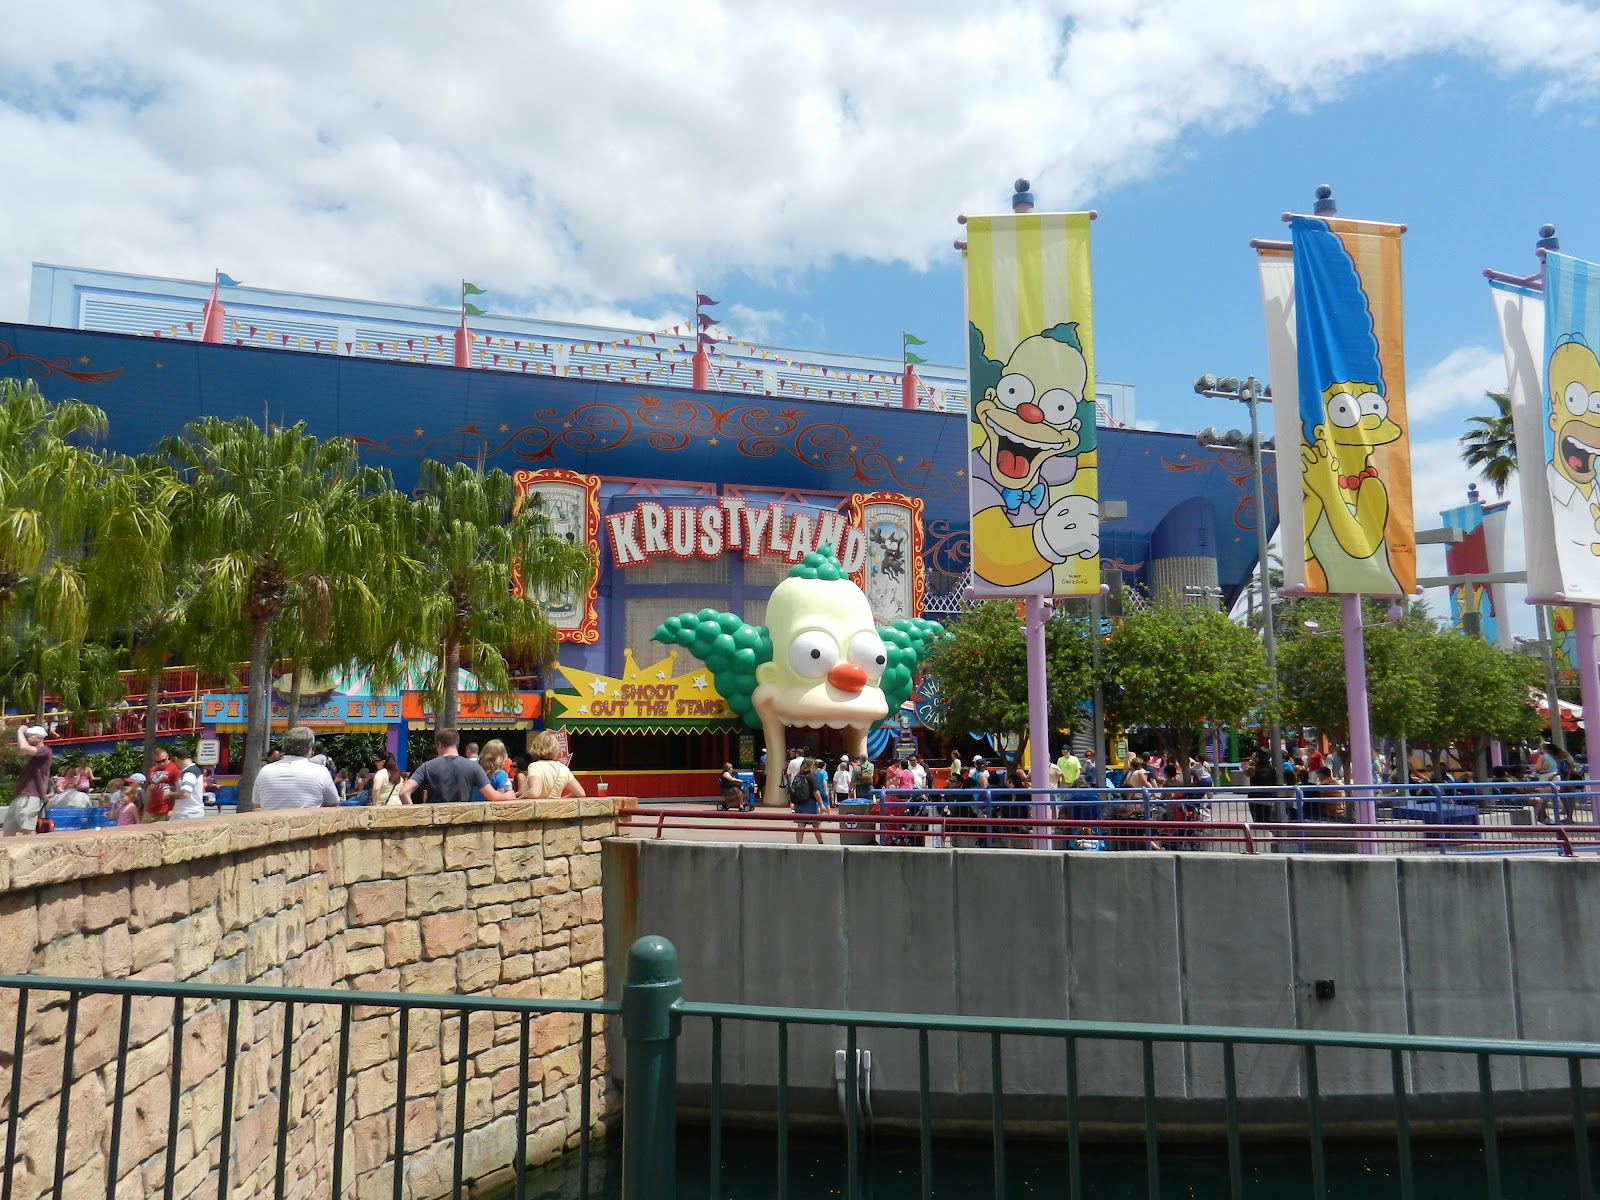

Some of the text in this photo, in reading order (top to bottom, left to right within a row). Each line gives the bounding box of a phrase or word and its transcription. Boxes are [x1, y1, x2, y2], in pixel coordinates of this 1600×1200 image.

[608, 497, 867, 575] KRUSTYLAND
[620, 684, 679, 700] SHOOT
[204, 700, 249, 717] PI
[298, 705, 340, 718] YOUR
[347, 701, 400, 718] EYE
[590, 699, 724, 717] OUT THE STARS
